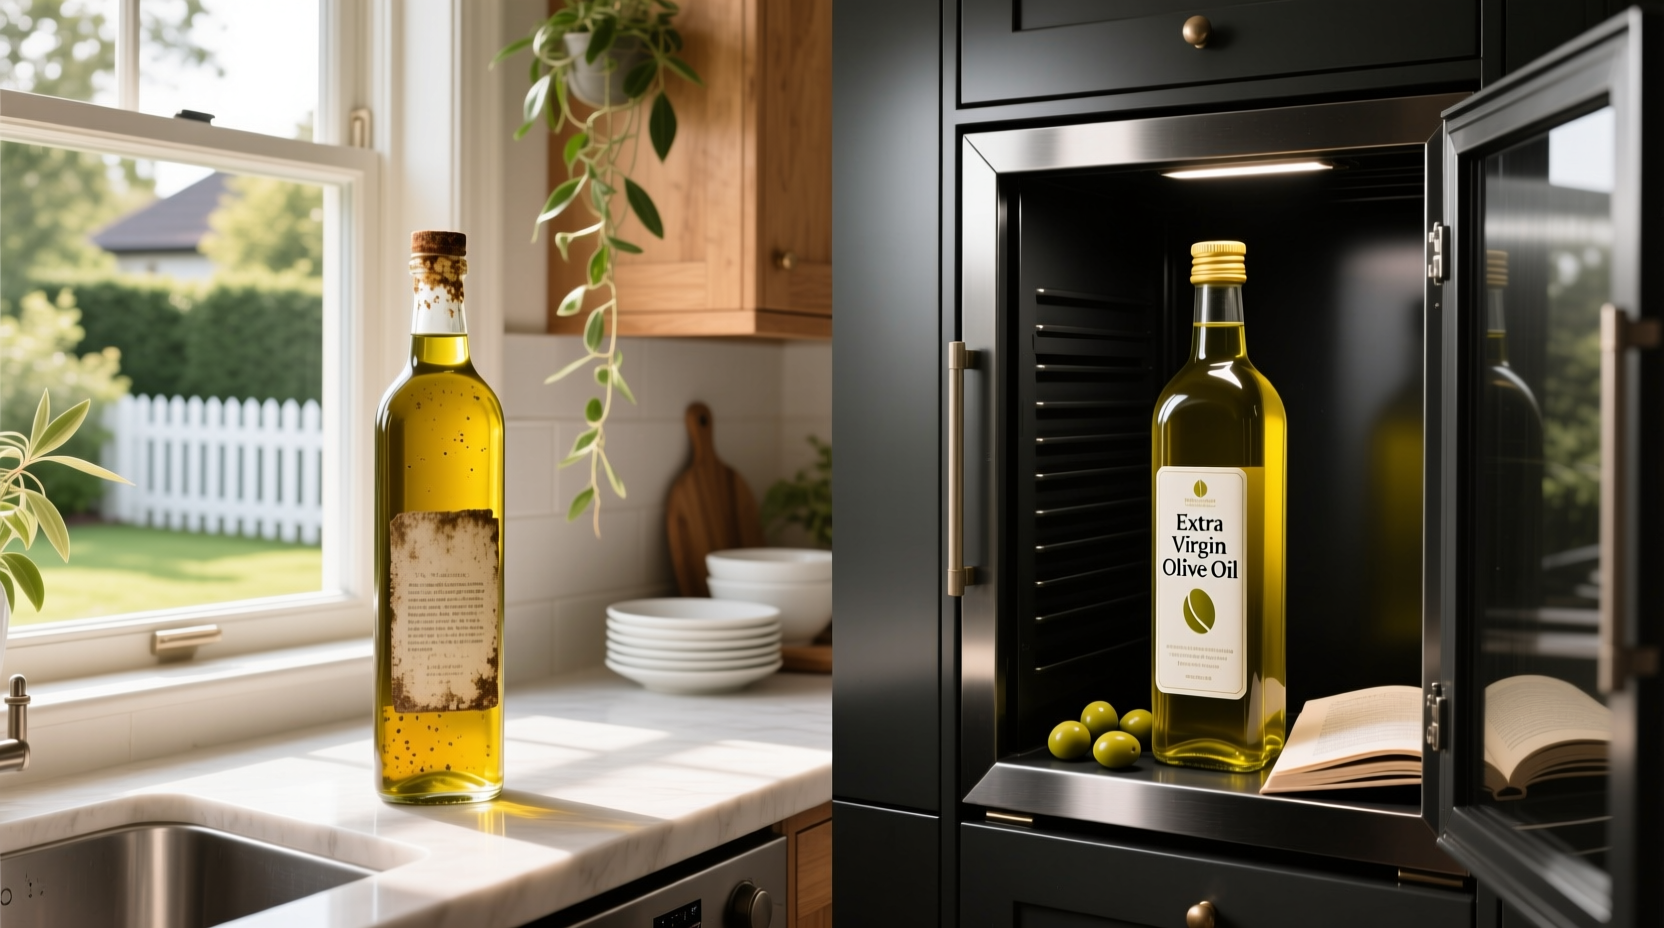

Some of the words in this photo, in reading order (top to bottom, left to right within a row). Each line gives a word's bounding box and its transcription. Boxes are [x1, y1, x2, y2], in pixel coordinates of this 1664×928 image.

[1176, 513, 1223, 532] Extra
[1171, 535, 1227, 559] Virgin
[1162, 558, 1207, 578] Olive
[1211, 560, 1238, 579] Oil
